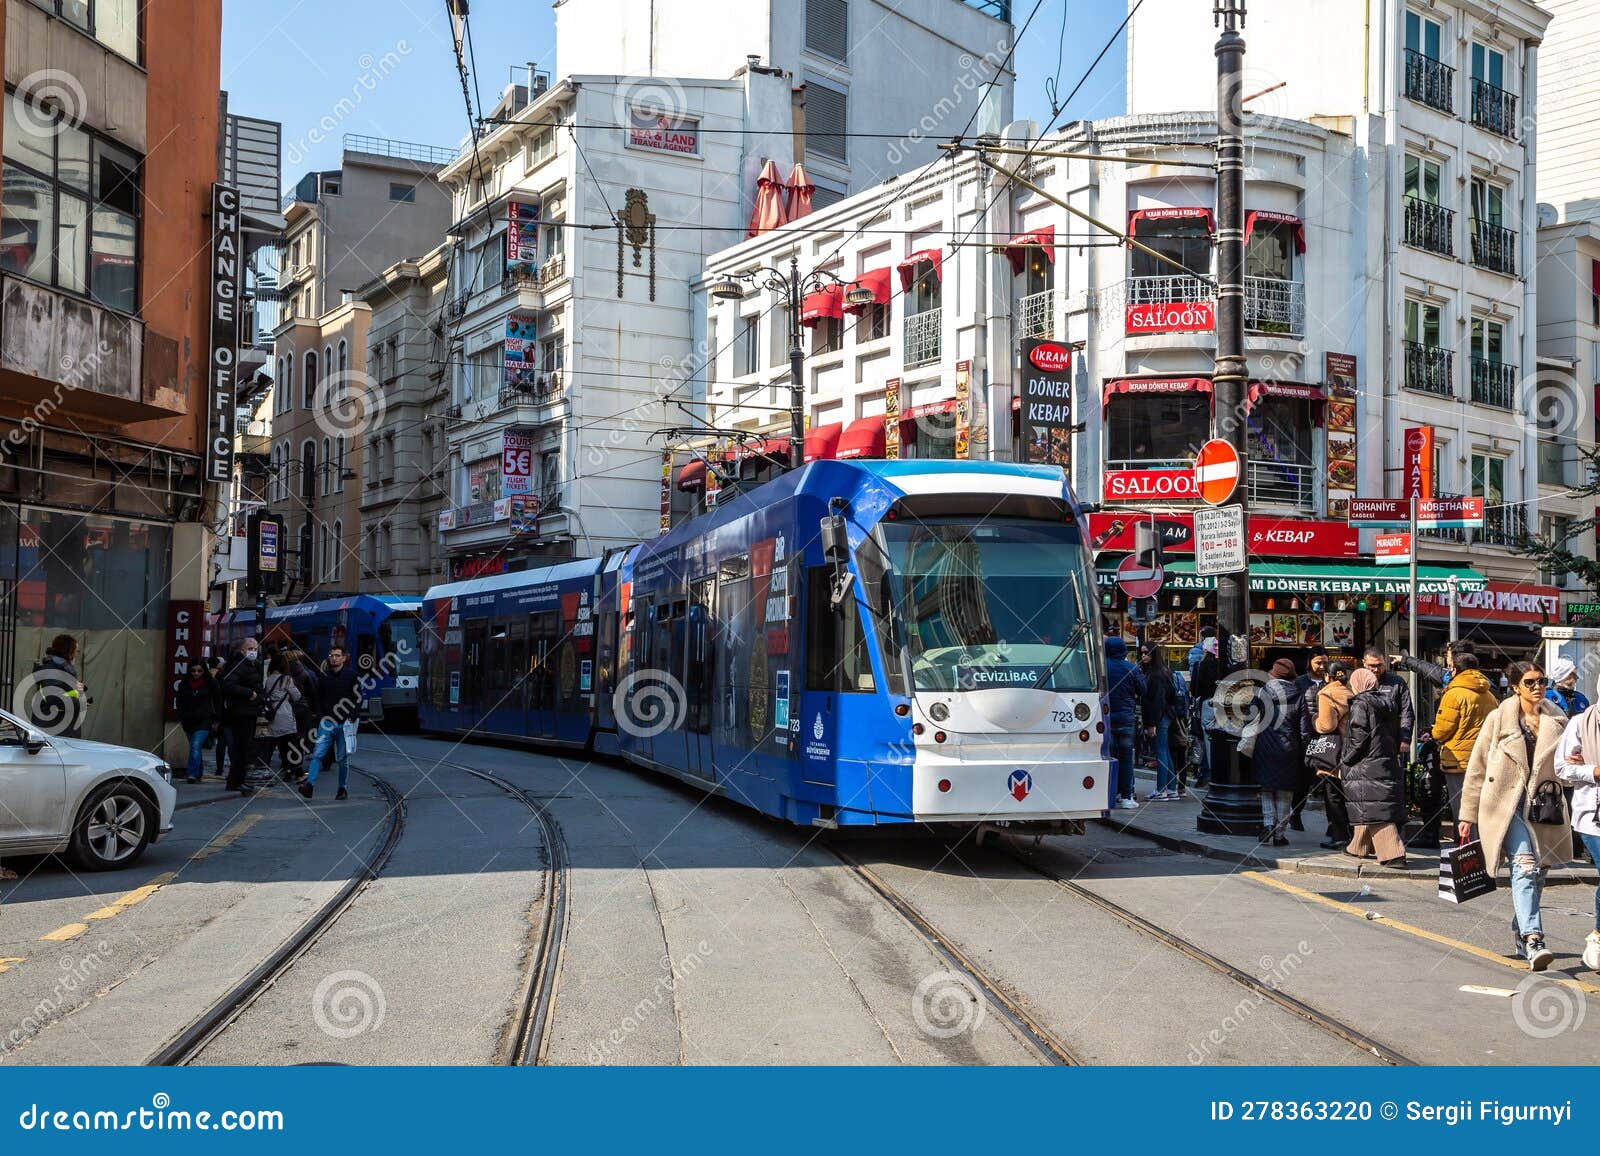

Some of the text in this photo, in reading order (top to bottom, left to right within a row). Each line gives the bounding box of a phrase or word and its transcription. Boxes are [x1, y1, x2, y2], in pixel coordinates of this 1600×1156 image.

[665, 133, 696, 146] LAND
[217, 190, 236, 322] CHANGE
[1132, 310, 1207, 327] SALOON
[1035, 349, 1069, 363] İKRAM
[1028, 376, 1070, 398] DÖNER
[213, 347, 233, 479] OFFICE
[1028, 403, 1070, 423] KEBAP
[504, 437, 532, 446] TOURS
[505, 450, 530, 474] 5€
[1420, 501, 1475, 512] NÖBETHANE
[1253, 530, 1315, 543] & KEBAP
[1267, 579, 1318, 591] DÖNER
[1320, 581, 1371, 592] KEBAP
[1495, 592, 1558, 614] MARKET
[973, 670, 1037, 682] CEVİZLİBAĞ
[1051, 711, 1073, 723] 723
[790, 719, 800, 732] 723
